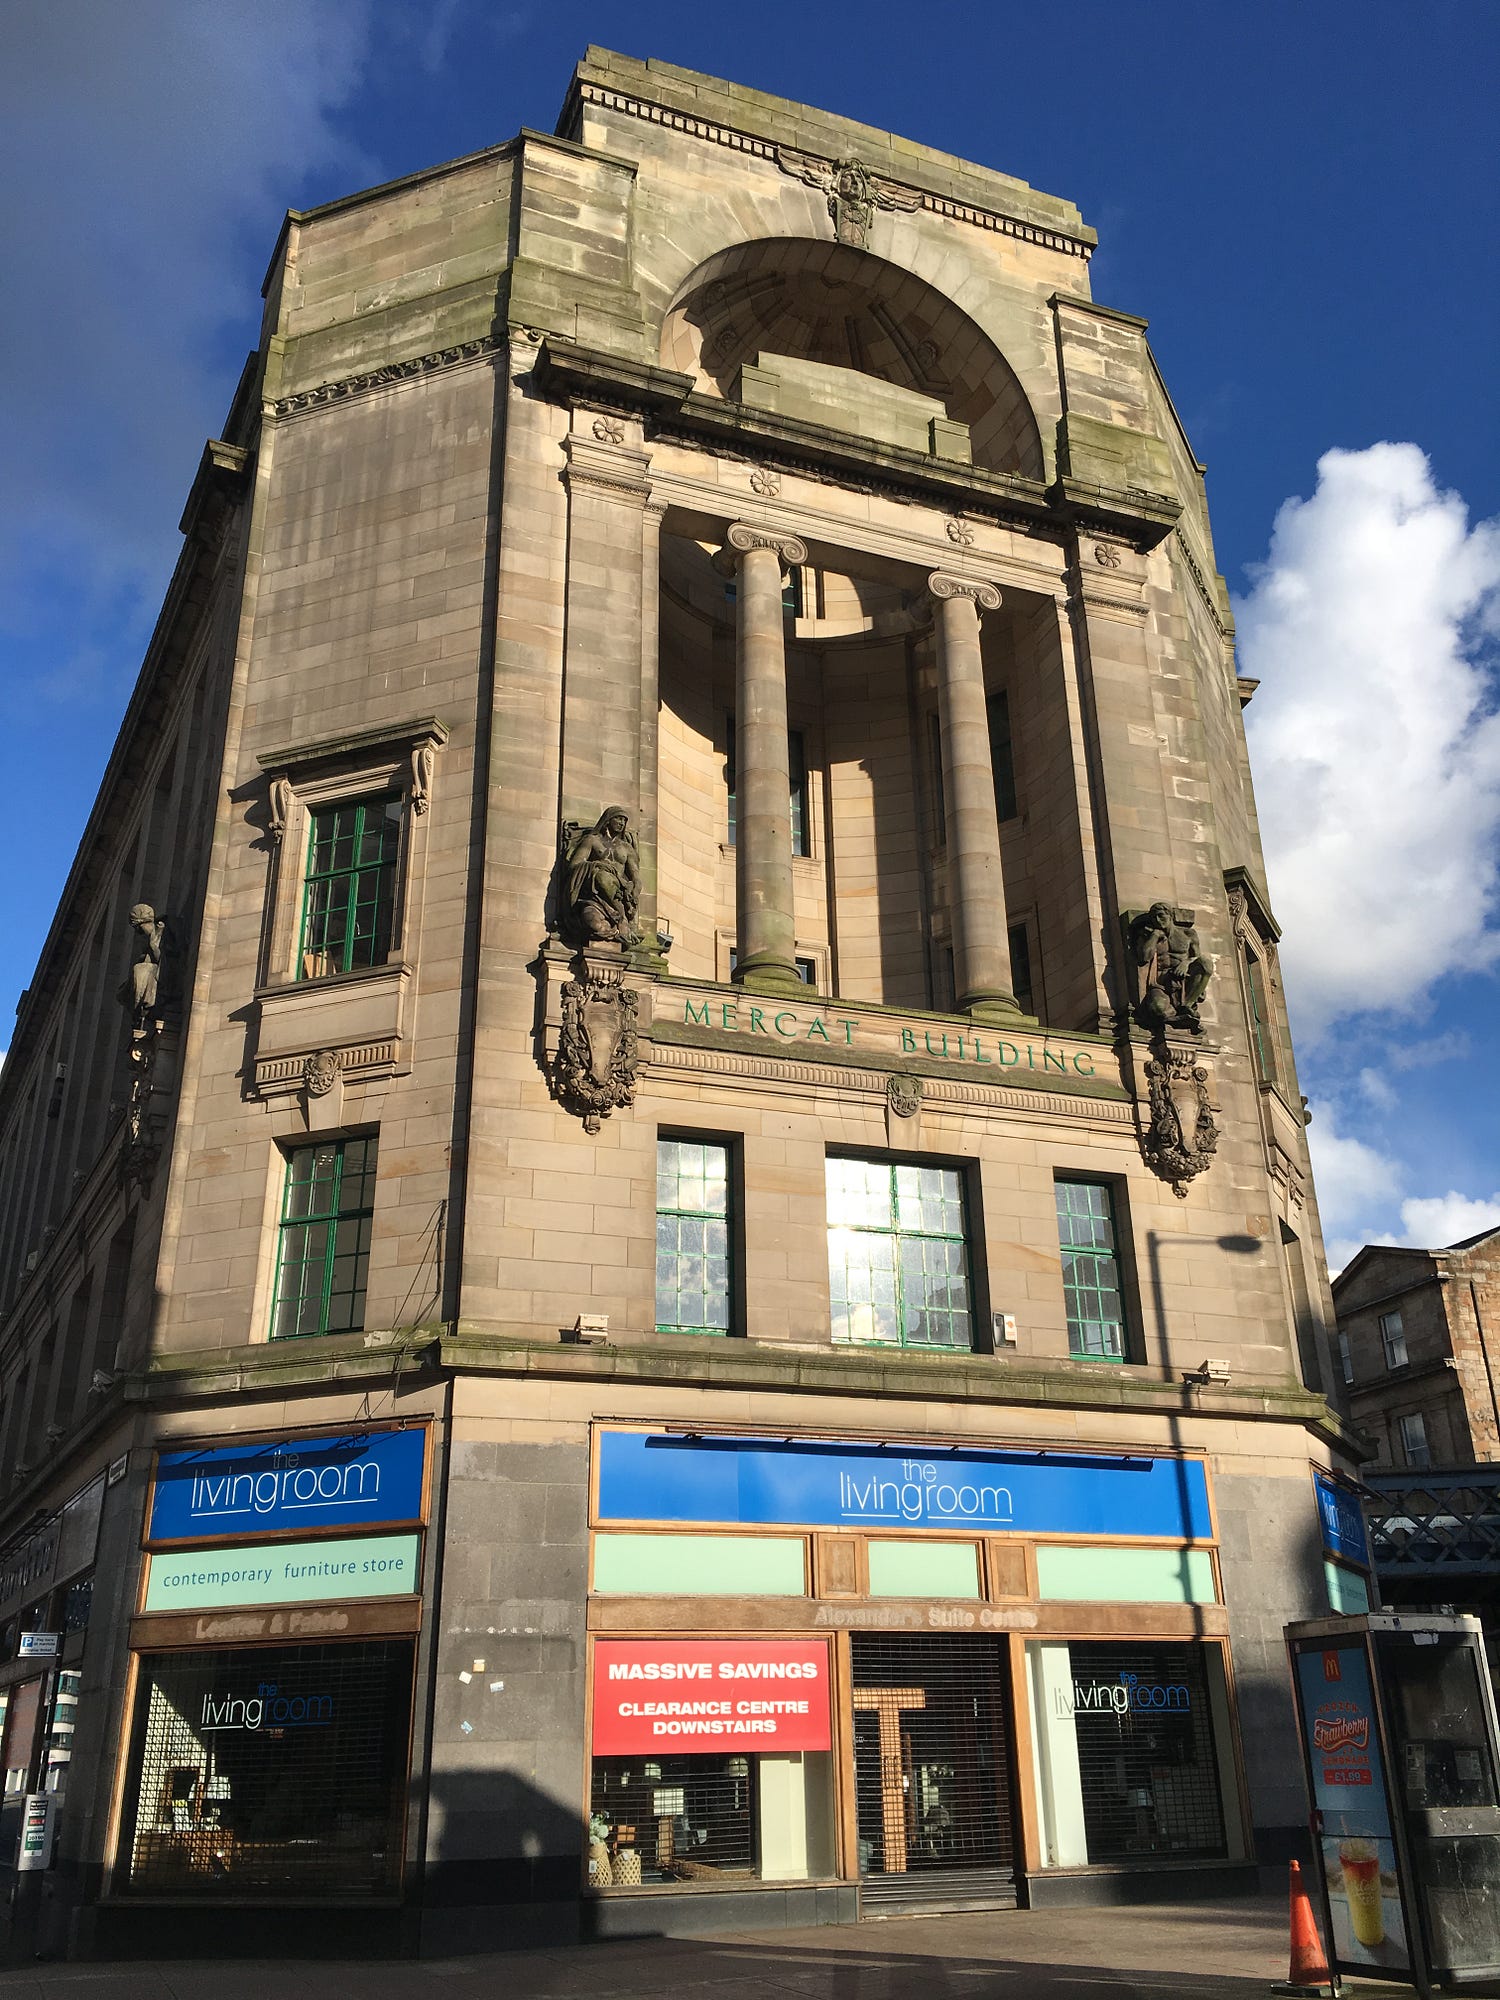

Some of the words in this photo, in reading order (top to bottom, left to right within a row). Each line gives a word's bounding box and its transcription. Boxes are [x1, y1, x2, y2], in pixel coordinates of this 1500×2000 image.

[684, 998, 859, 1045] MERCAT
[902, 1027, 1096, 1076] BUILDING
[272, 1450, 300, 1469] the
[901, 1459, 937, 1482] the
[163, 1568, 273, 1587] contemporary
[284, 1560, 357, 1578] furniture
[362, 1558, 404, 1573] store
[608, 1663, 712, 1680] MASSIVE
[718, 1662, 818, 1679] SAVINGS
[1119, 1671, 1138, 1686] the
[257, 1680, 278, 1697] the
[618, 1701, 732, 1717] CLEARANCE
[736, 1700, 809, 1715] CENTRE
[653, 1719, 777, 1735] DOWNSTAIRS
[1314, 1717, 1369, 1752] Strawberry
